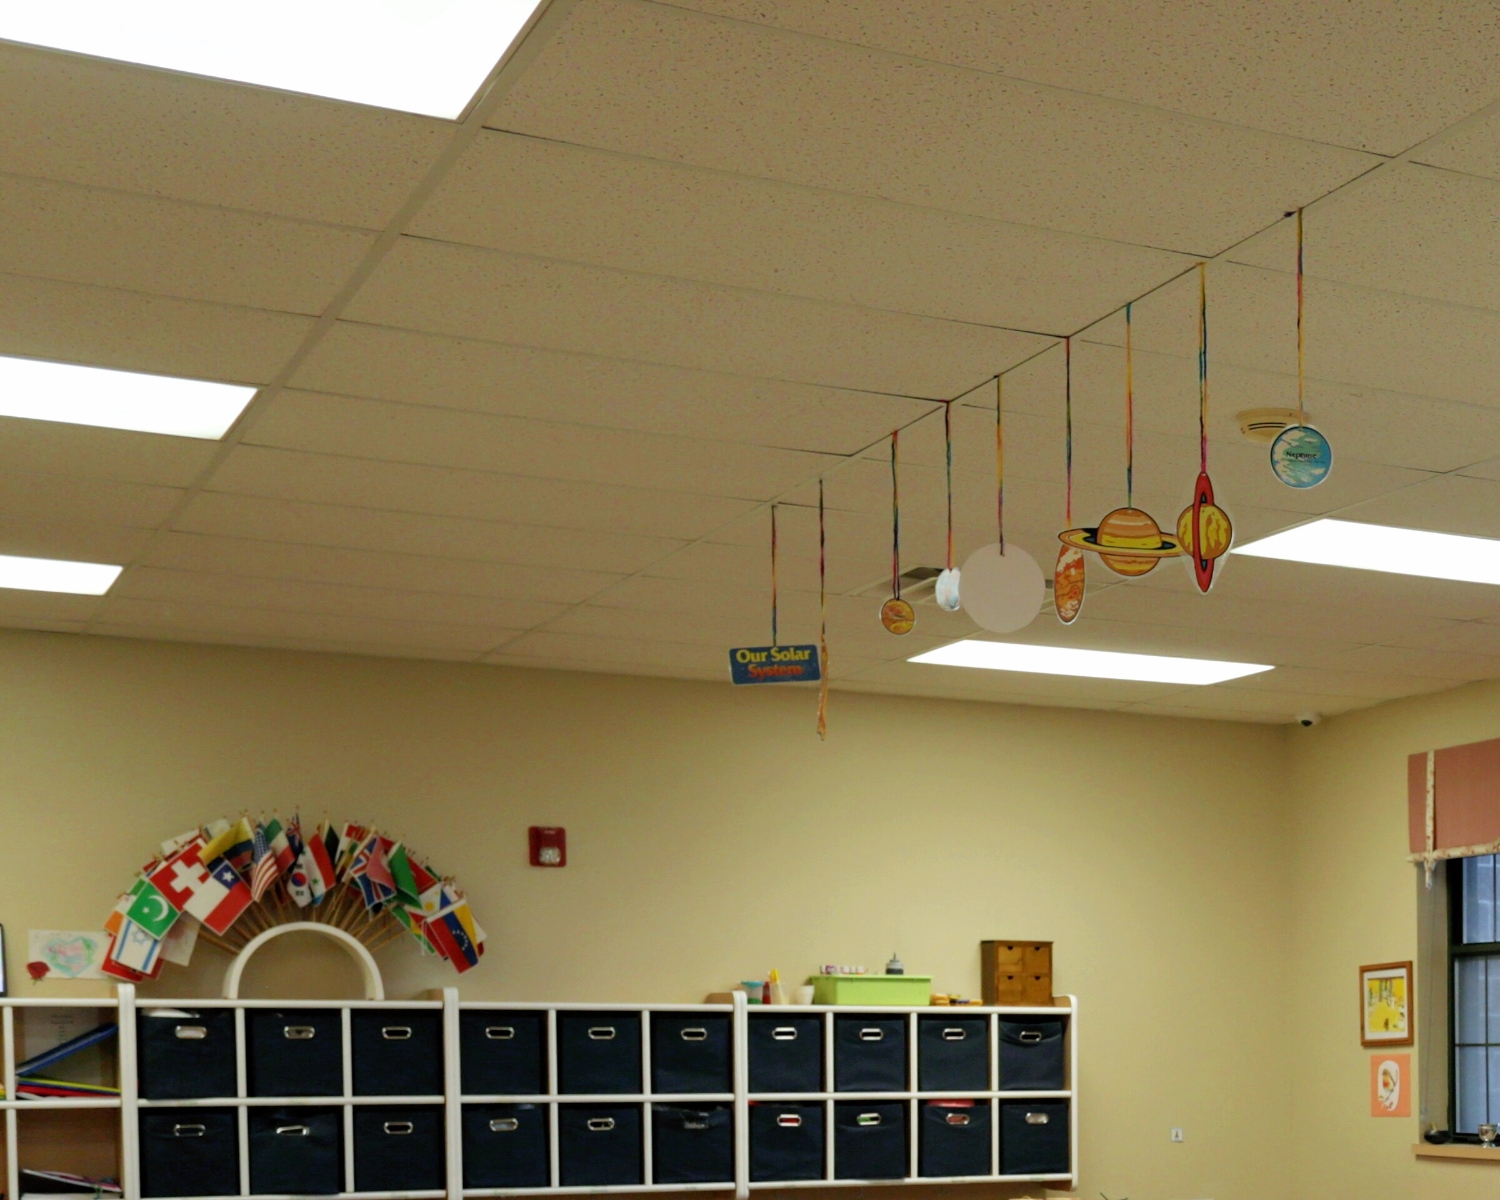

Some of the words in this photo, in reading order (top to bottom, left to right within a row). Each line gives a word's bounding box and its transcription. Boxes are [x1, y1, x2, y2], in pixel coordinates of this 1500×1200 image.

[736, 649, 768, 664] Our
[770, 647, 811, 662] Solar
[748, 663, 803, 680] System
